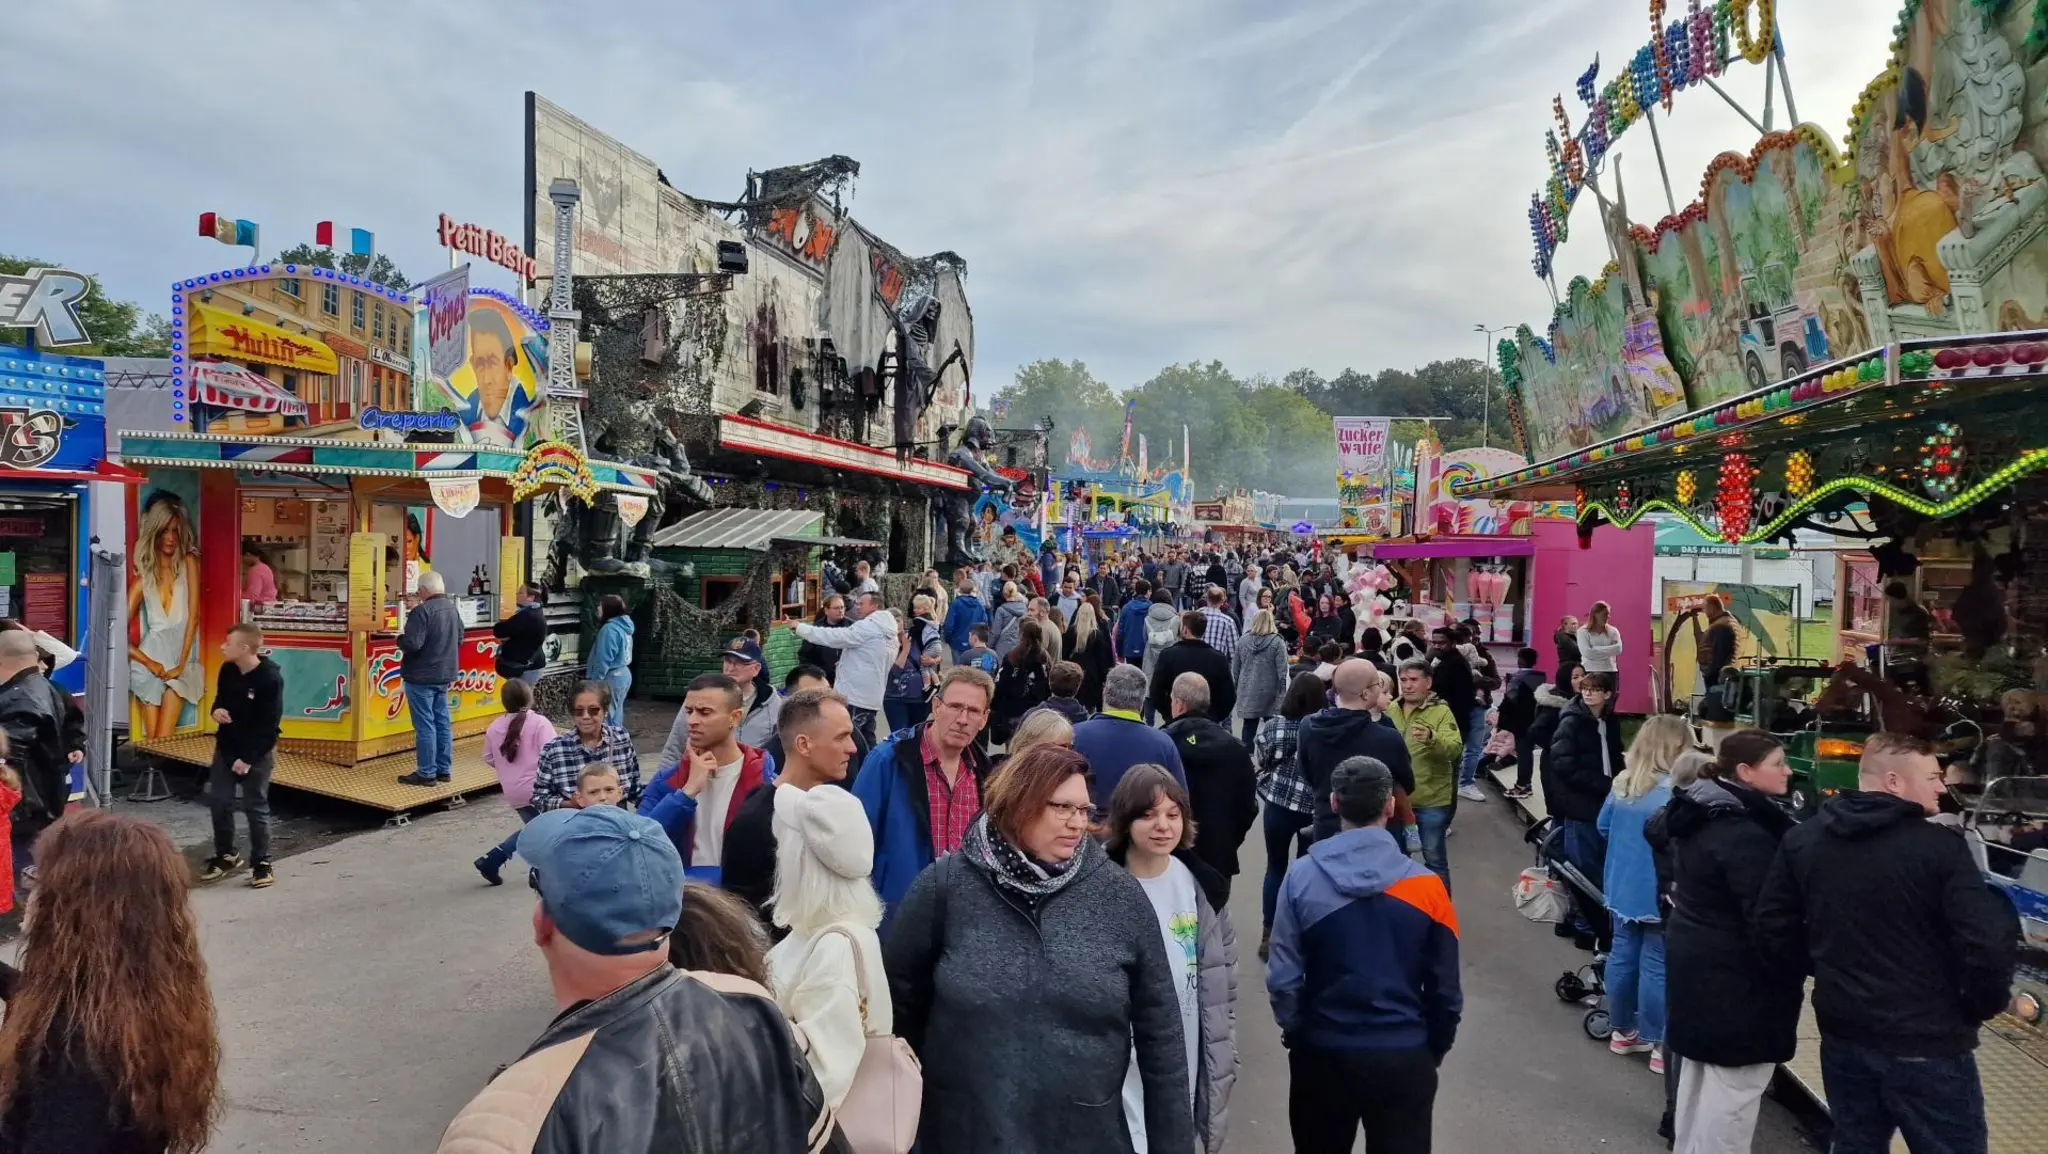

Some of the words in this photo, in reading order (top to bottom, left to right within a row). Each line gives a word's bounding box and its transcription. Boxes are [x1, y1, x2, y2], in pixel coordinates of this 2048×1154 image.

[438, 212, 488, 257] Petit
[486, 229, 537, 281] Bistro
[1681, 546, 1698, 554] DAS
[1700, 546, 1743, 555] ALPENBIE
